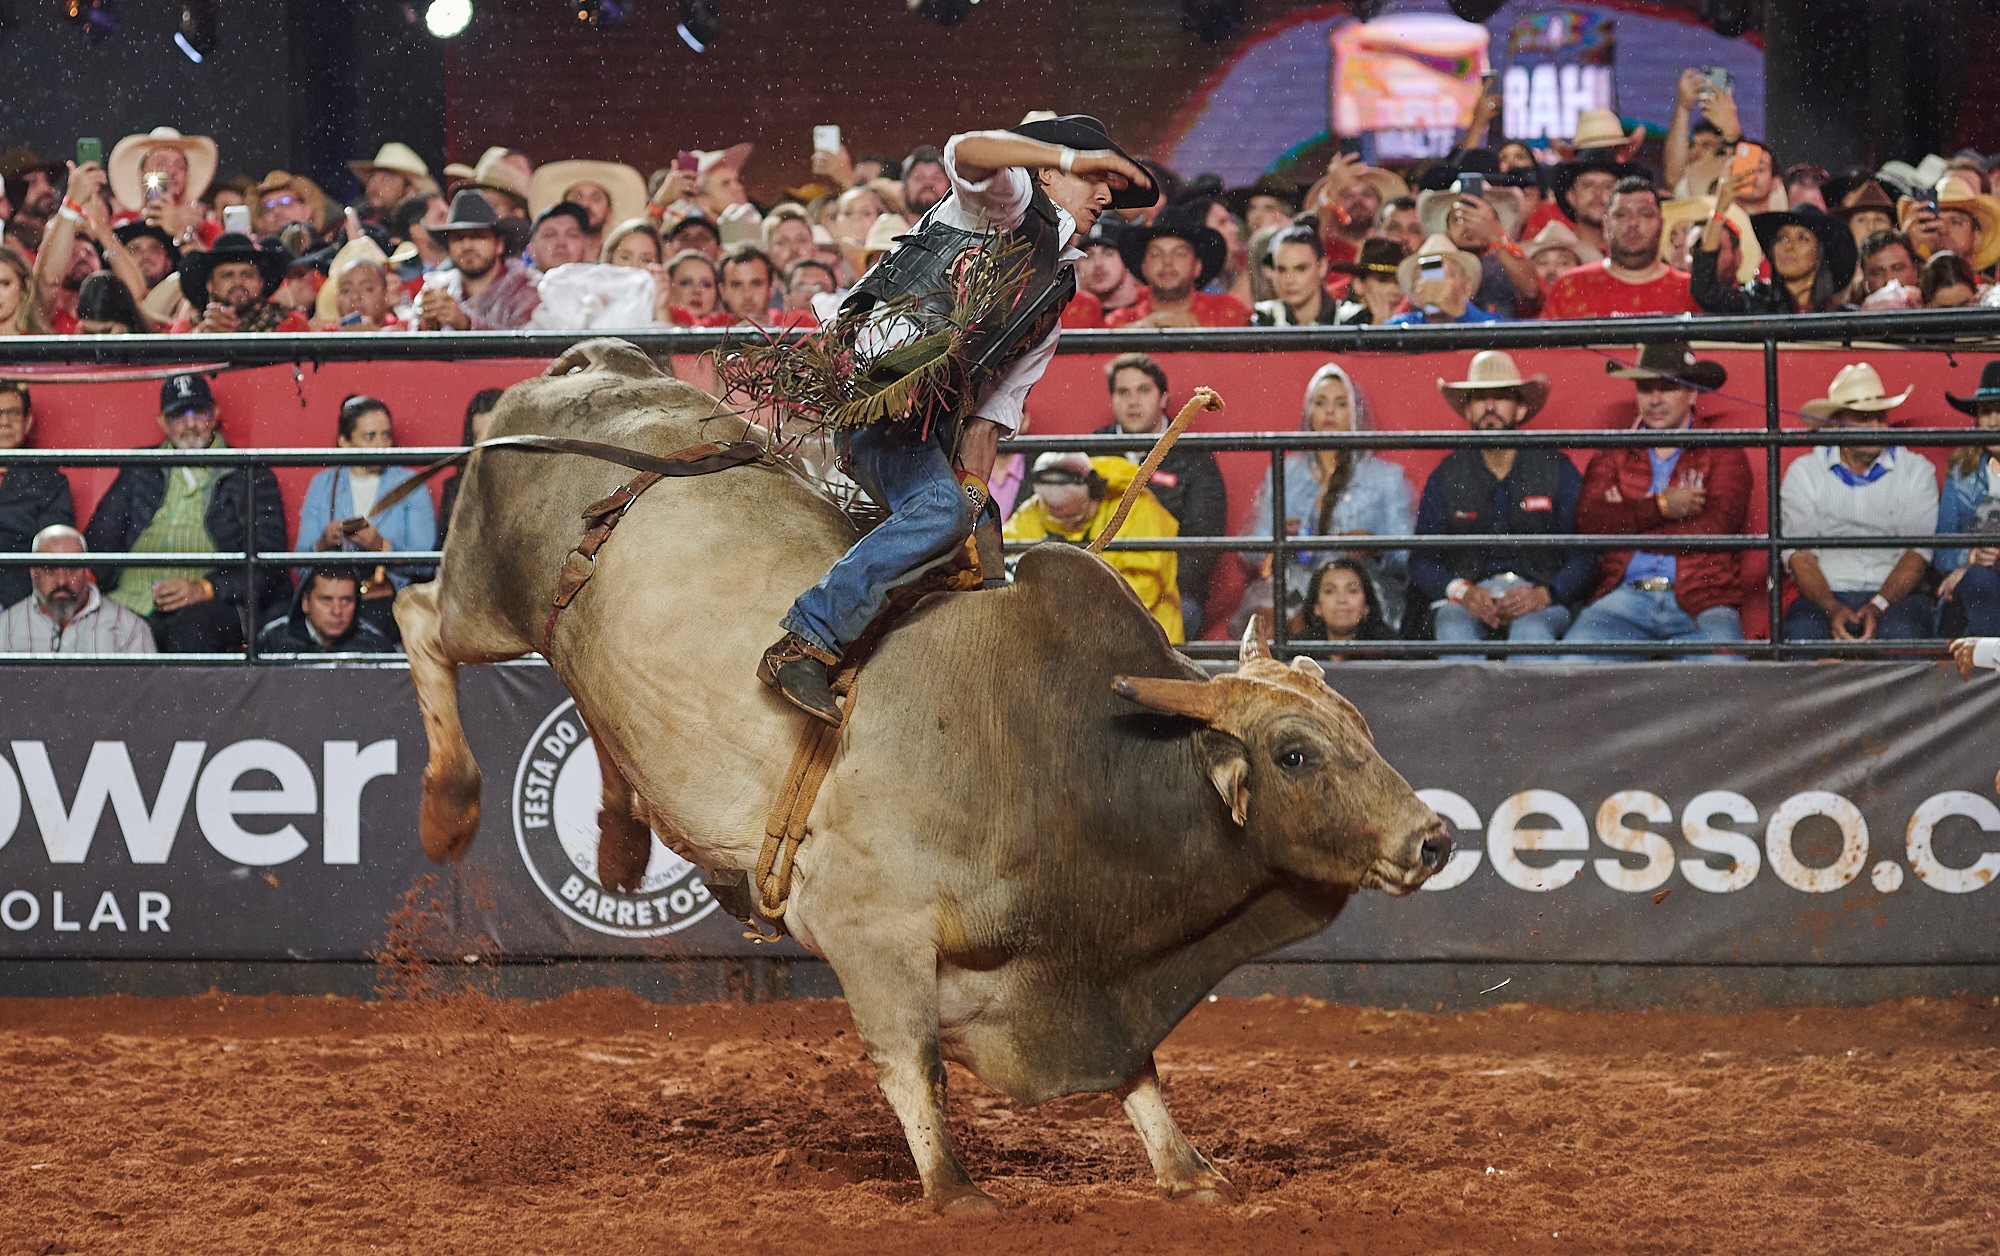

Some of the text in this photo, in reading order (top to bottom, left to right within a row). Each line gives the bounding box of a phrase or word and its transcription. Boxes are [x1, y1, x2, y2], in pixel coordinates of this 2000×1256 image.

[0, 738, 398, 866] wer
[523, 719, 578, 829] FESTA DO
[559, 873, 712, 927] BARRETOS
